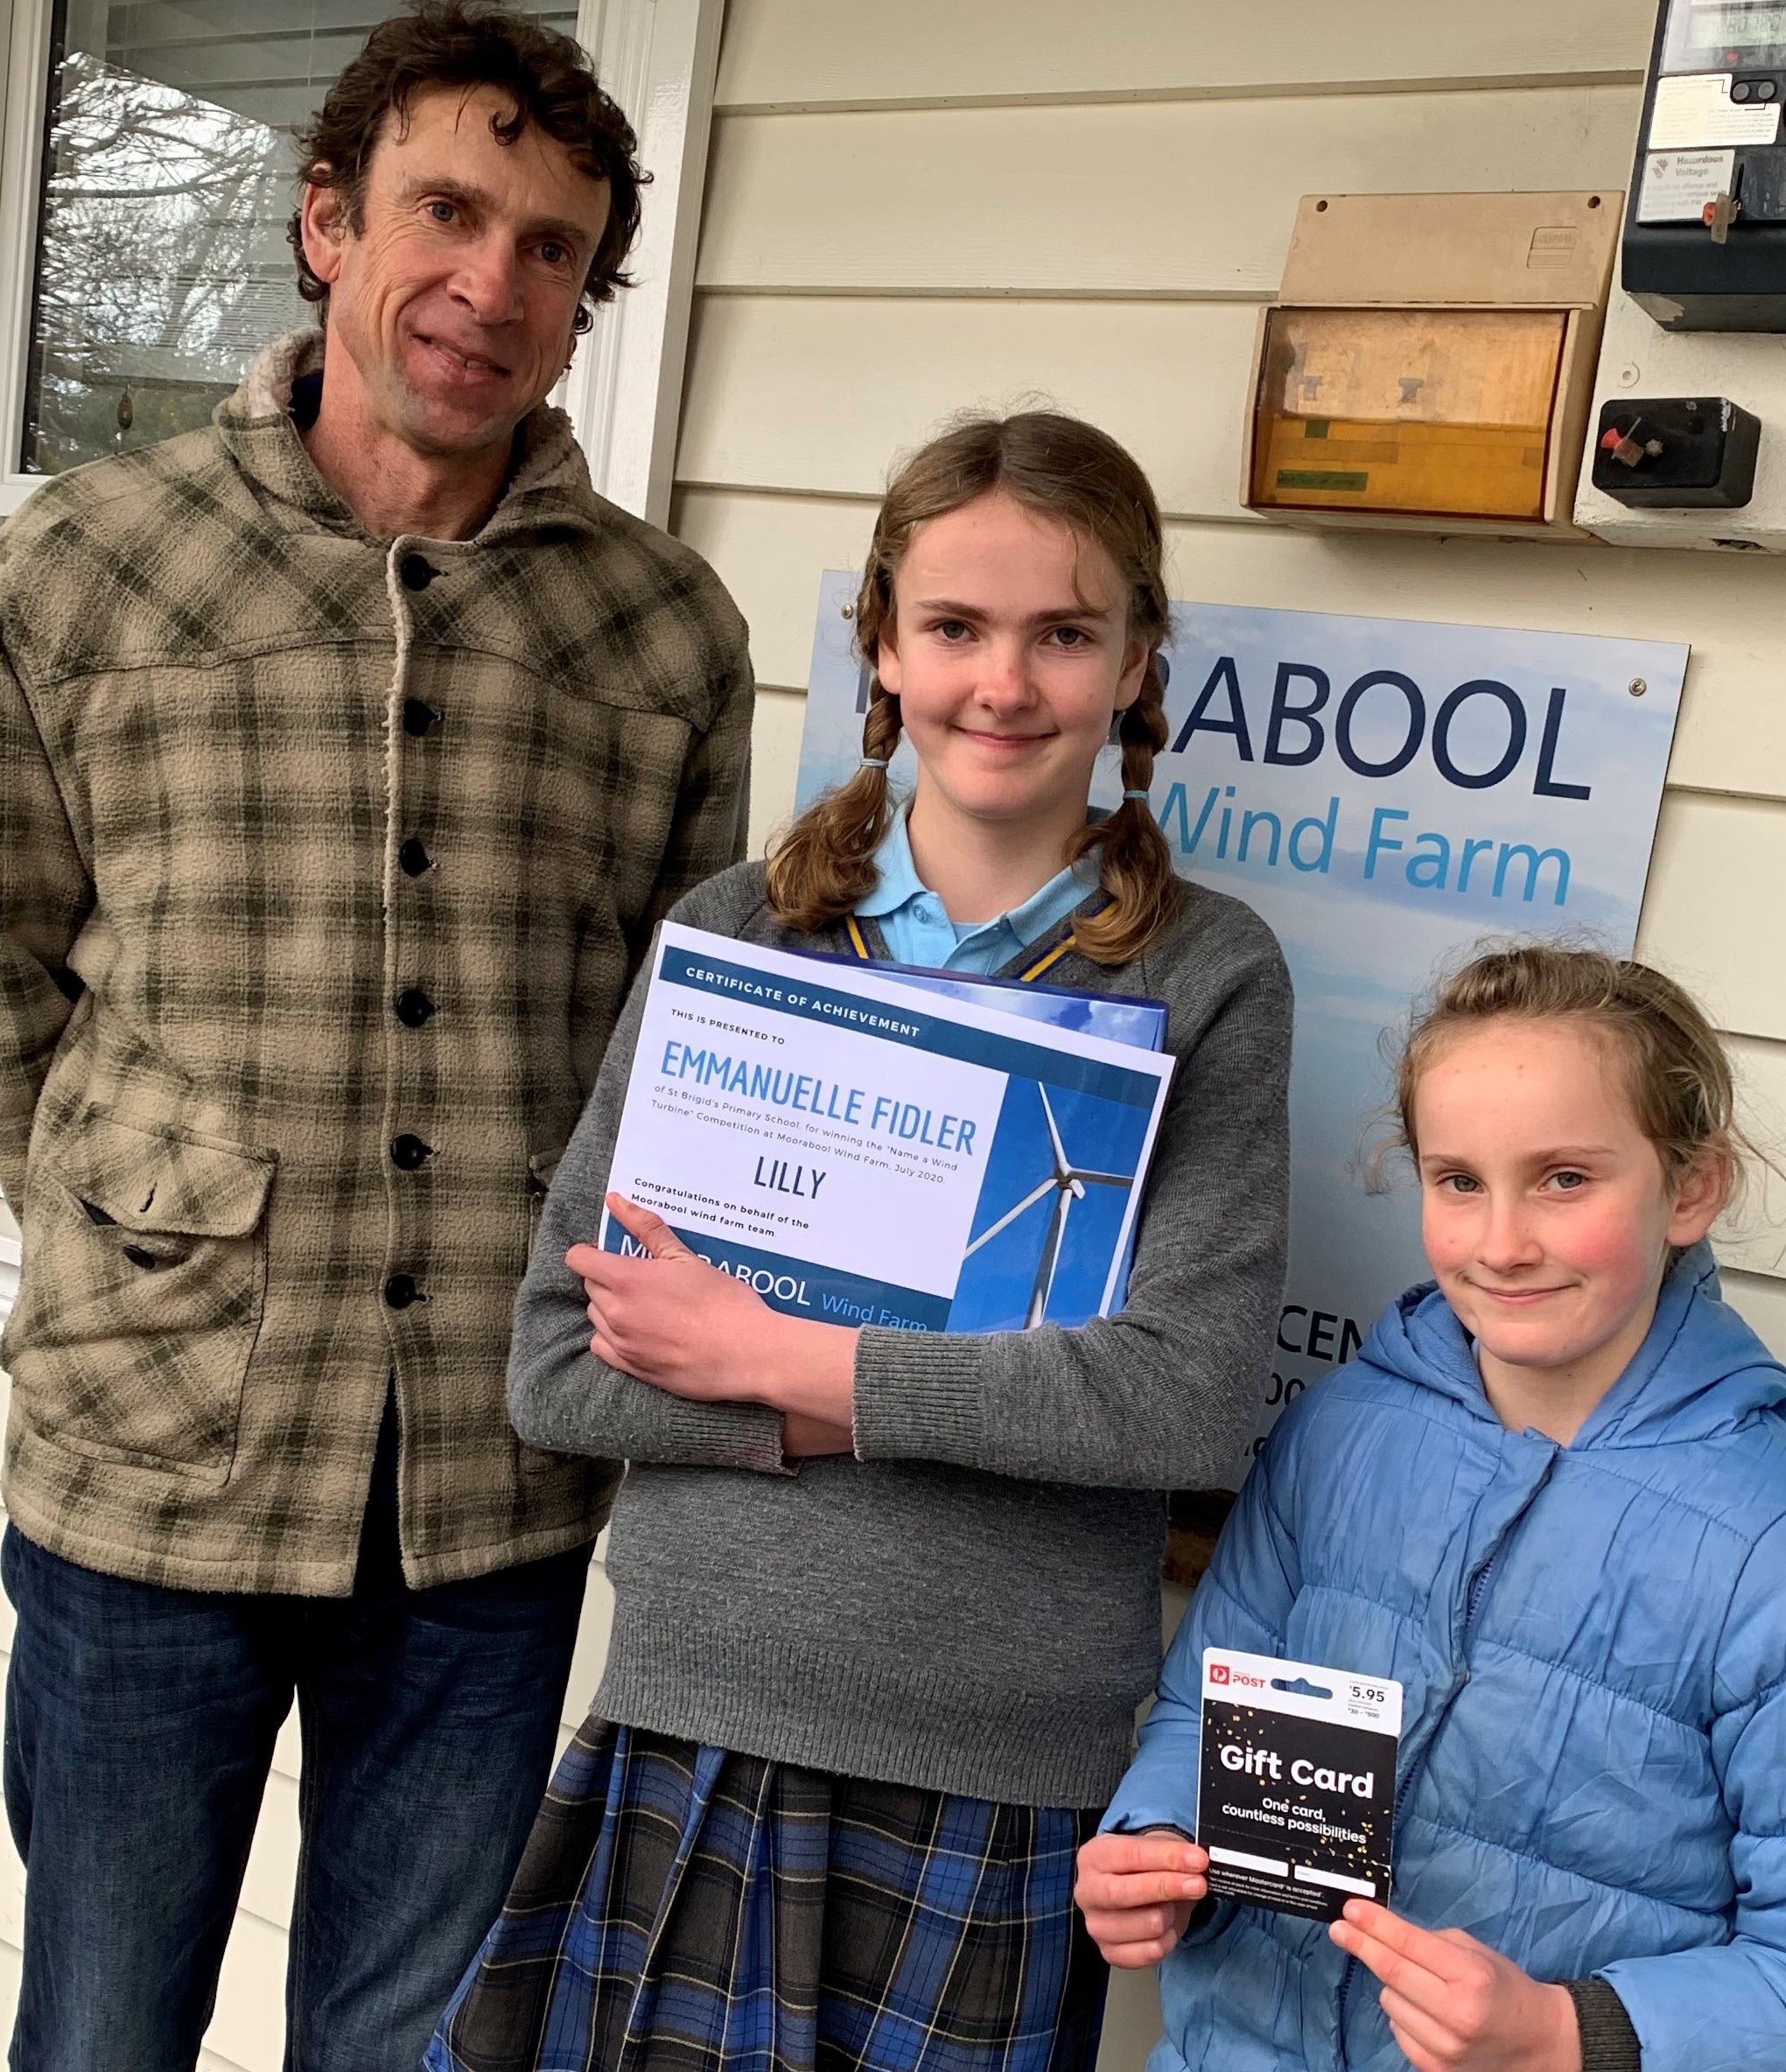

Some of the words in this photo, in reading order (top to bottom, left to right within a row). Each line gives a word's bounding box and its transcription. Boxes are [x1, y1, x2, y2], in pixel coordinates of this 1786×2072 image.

[1363, 807, 1572, 906] Farm
[685, 966, 783, 1002] CERTIFICATE
[787, 993, 808, 1007] OF
[811, 1000, 921, 1039] ACHIEVEMENT
[670, 1008, 694, 1022] THIS
[697, 1015, 707, 1025] IS
[709, 1019, 769, 1041] PRESENTED
[771, 1035, 786, 1046] TO
[661, 1040, 866, 1126] EMMANUELLE
[871, 1096, 977, 1157] FIDLER
[655, 1085, 666, 1094] of
[667, 1088, 678, 1097] St
[681, 1091, 719, 1109] Brigid's
[722, 1102, 762, 1121] Primary
[804, 1124, 820, 1135] for
[822, 1127, 864, 1147] winning
[866, 1140, 884, 1152] the
[931, 1158, 959, 1172] Wind
[696, 1112, 760, 1136] Competition
[763, 1129, 774, 1139] at
[776, 1133, 831, 1153] Moorabool
[833, 1147, 861, 1161] Wind
[893, 1164, 916, 1178] July
[753, 1156, 827, 1200] LILLY
[631, 1193, 688, 1214] Moorabool
[690, 1209, 718, 1222] wind
[719, 1216, 745, 1229] farm
[634, 1178, 721, 1207] Congratulations
[723, 1200, 738, 1211] on
[740, 1205, 775, 1221] behalf
[777, 1214, 790, 1224] of
[792, 1217, 809, 1229] the
[822, 1293, 875, 1322] Wind
[1232, 1675, 1267, 1690] POST
[1220, 1744, 1283, 1781] Gift
[1291, 1760, 1375, 1799] Card
[1222, 1803, 1285, 1828] countless
[1287, 1817, 1368, 1845] possibilities
[1262, 1797, 1290, 1814] One
[1292, 1804, 1327, 1823] card,
